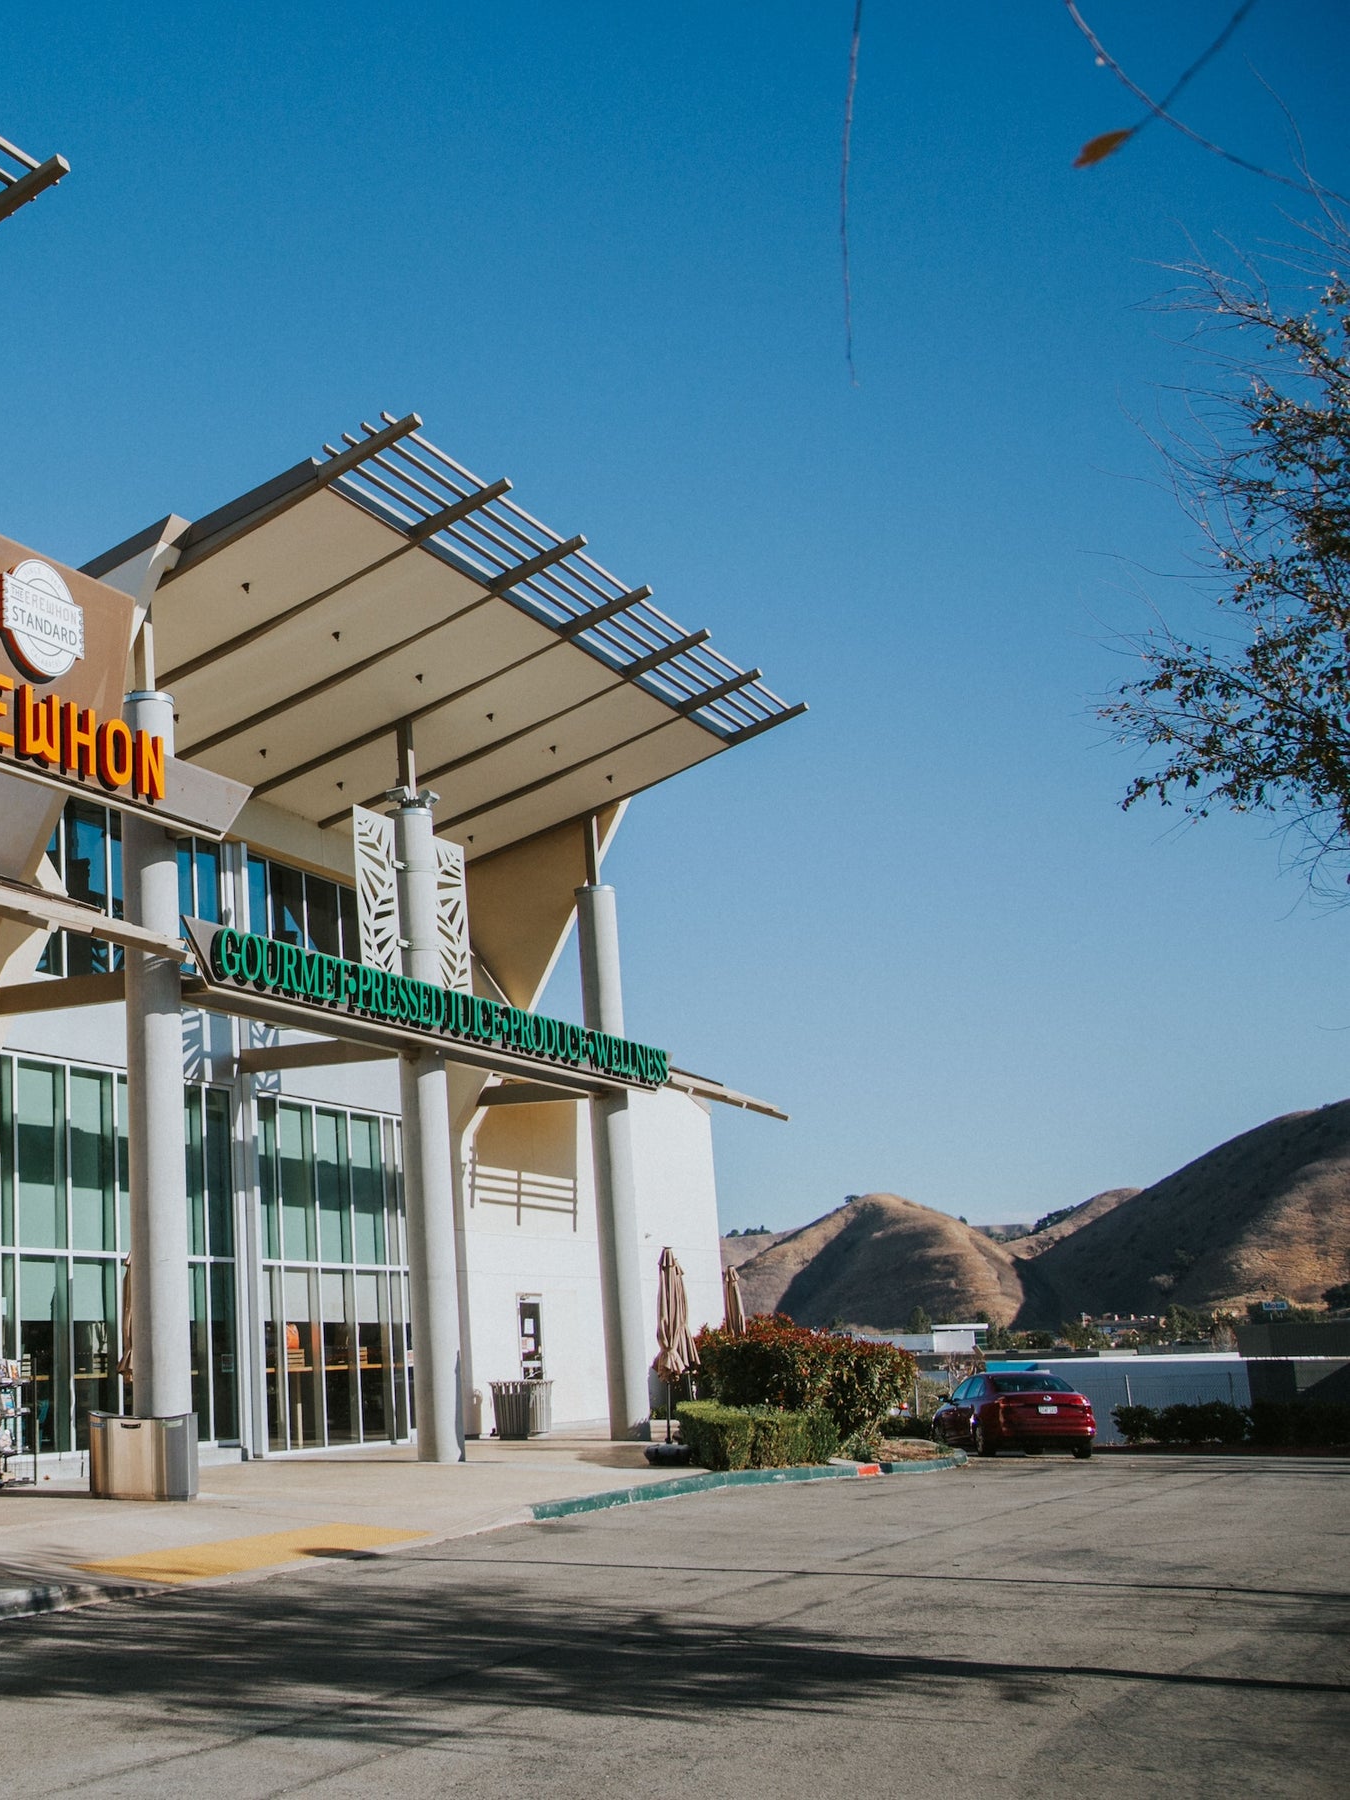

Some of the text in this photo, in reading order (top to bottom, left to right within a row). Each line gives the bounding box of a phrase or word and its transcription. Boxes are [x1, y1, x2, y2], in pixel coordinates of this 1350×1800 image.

[11, 586, 77, 626] THE EREWHON
[12, 605, 77, 646] STANDARD
[220, 927, 669, 1084] GOURMET PRESSED JUICE PRODUCE WELLNESS
